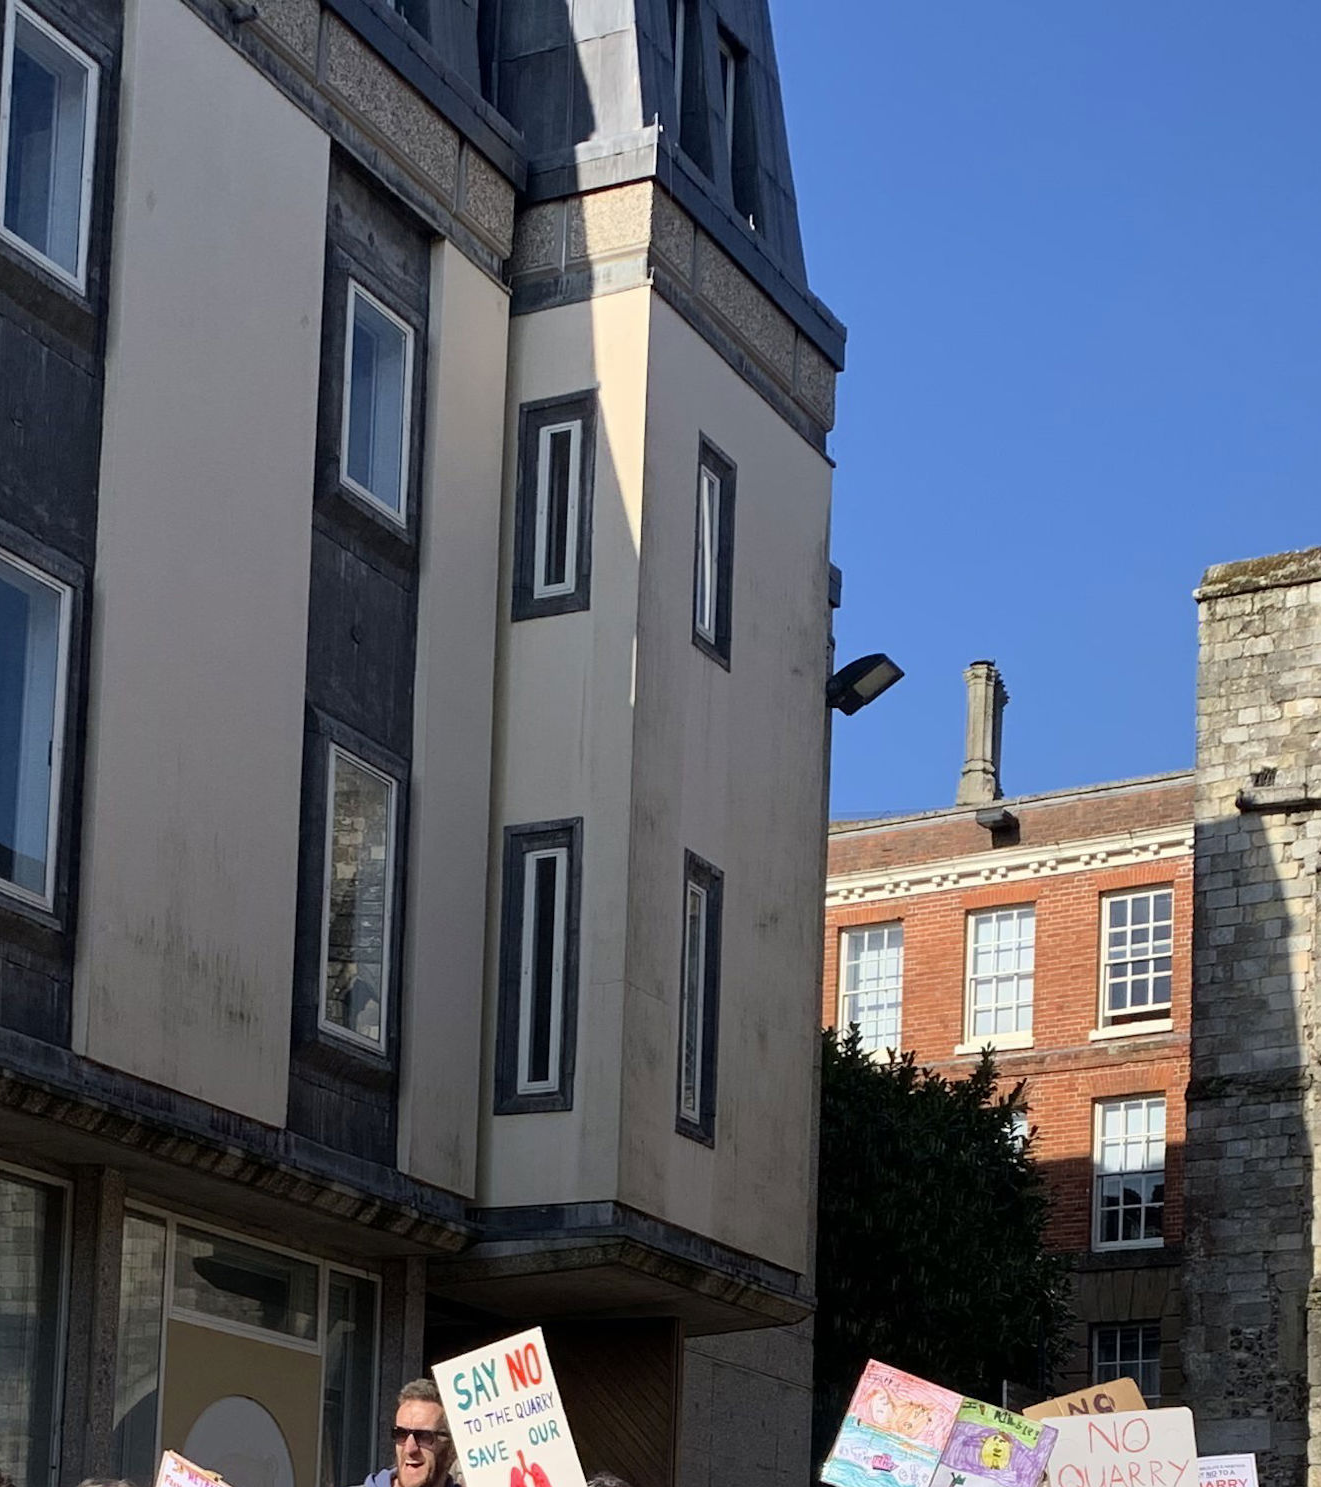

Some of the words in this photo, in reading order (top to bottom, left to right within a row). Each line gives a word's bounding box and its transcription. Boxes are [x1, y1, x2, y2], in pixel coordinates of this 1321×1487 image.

[453, 1358, 500, 1411] SAY
[505, 1342, 543, 1392] NO
[464, 1419, 482, 1435] TO
[484, 1406, 513, 1429] THE
[515, 1391, 556, 1419] QUARRY
[1067, 1393, 1116, 1416] NO
[467, 1440, 509, 1468] SAVE
[529, 1419, 561, 1446] OUR
[1088, 1418, 1150, 1453] NO
